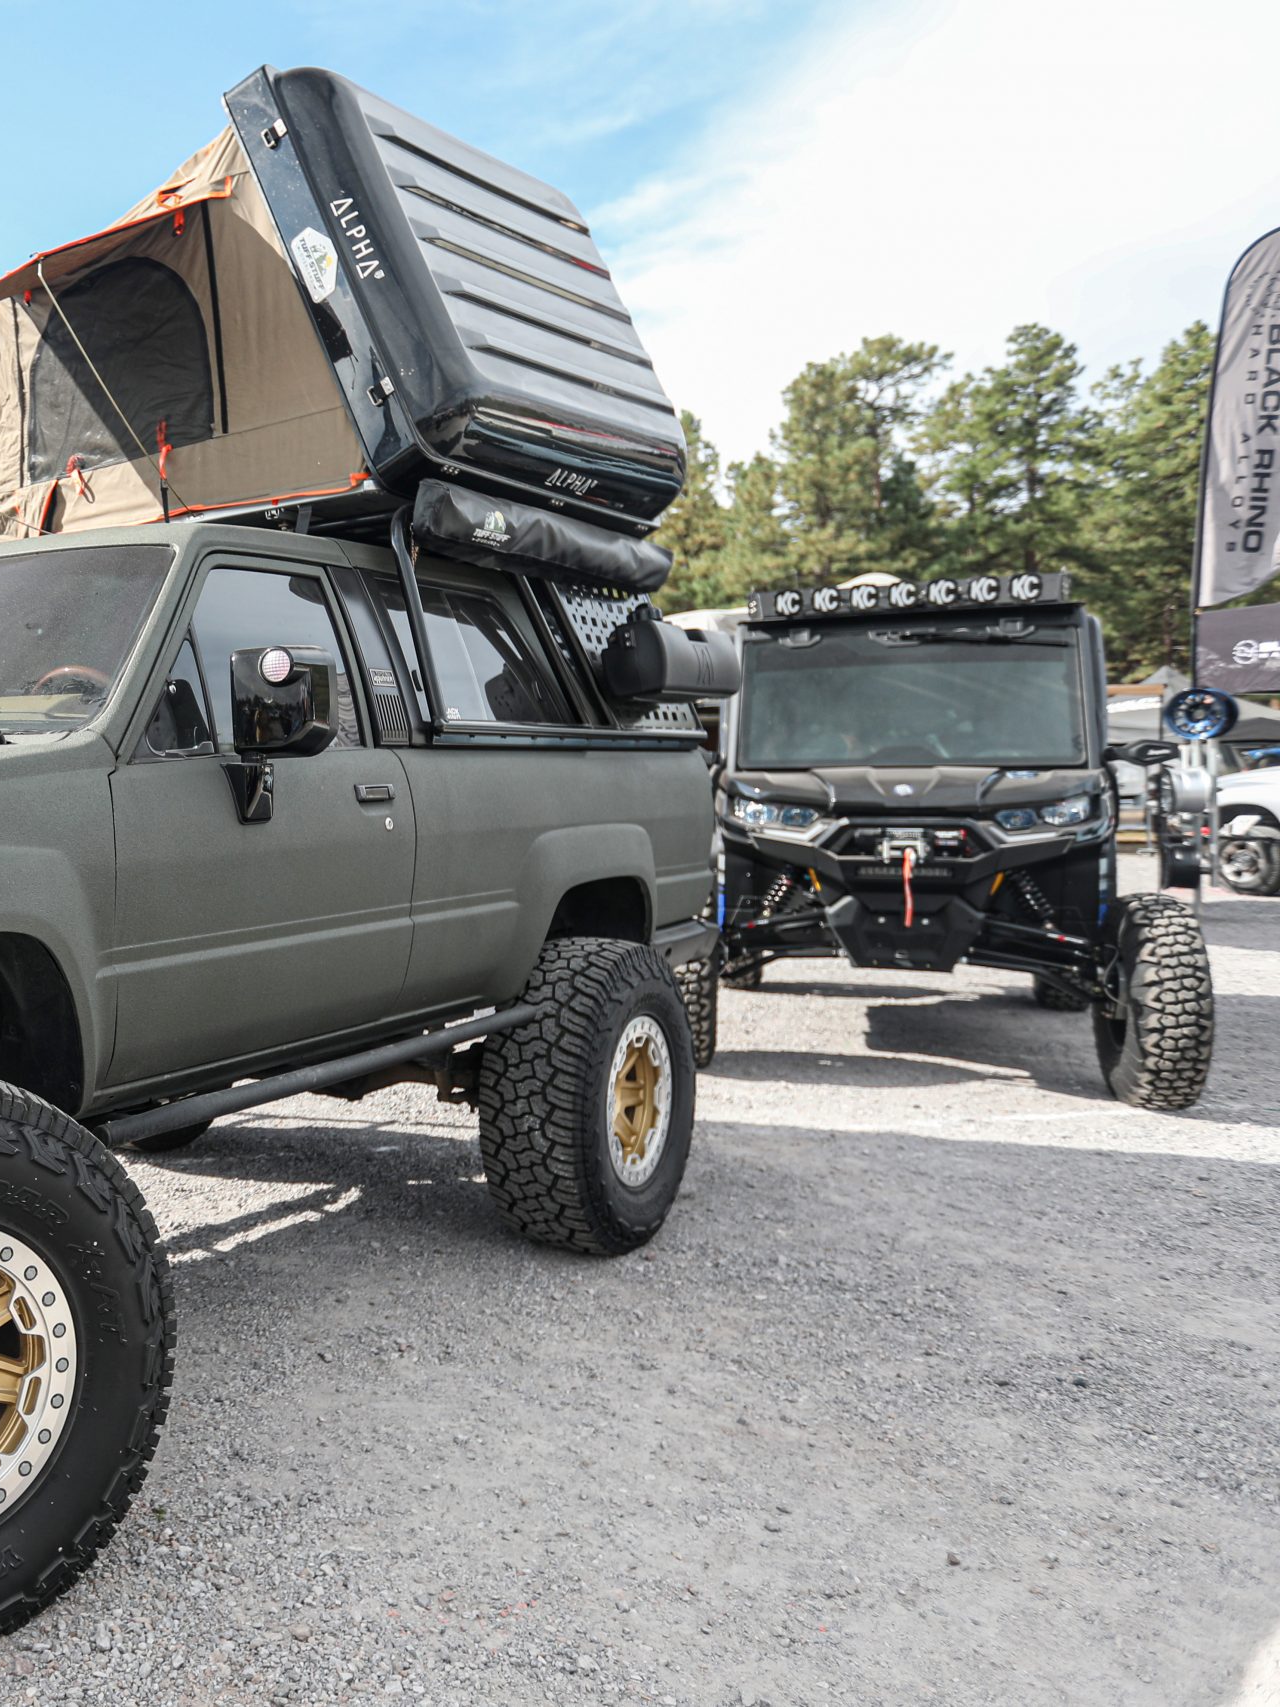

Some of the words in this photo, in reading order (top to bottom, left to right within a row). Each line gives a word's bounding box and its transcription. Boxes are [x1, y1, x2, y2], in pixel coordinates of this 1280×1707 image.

[299, 237, 314, 262] TUFF
[308, 260, 326, 290] STUFF
[329, 198, 380, 279] ALPHA
[1256, 324, 1280, 435] BLACK
[1241, 449, 1276, 553] RHINO
[776, 591, 800, 615] KC
[814, 587, 838, 612] KC
[851, 585, 876, 609] KC
[890, 582, 916, 607] KC
[929, 579, 955, 605] KC
[970, 577, 997, 602] KC
[1011, 574, 1039, 600] KC
